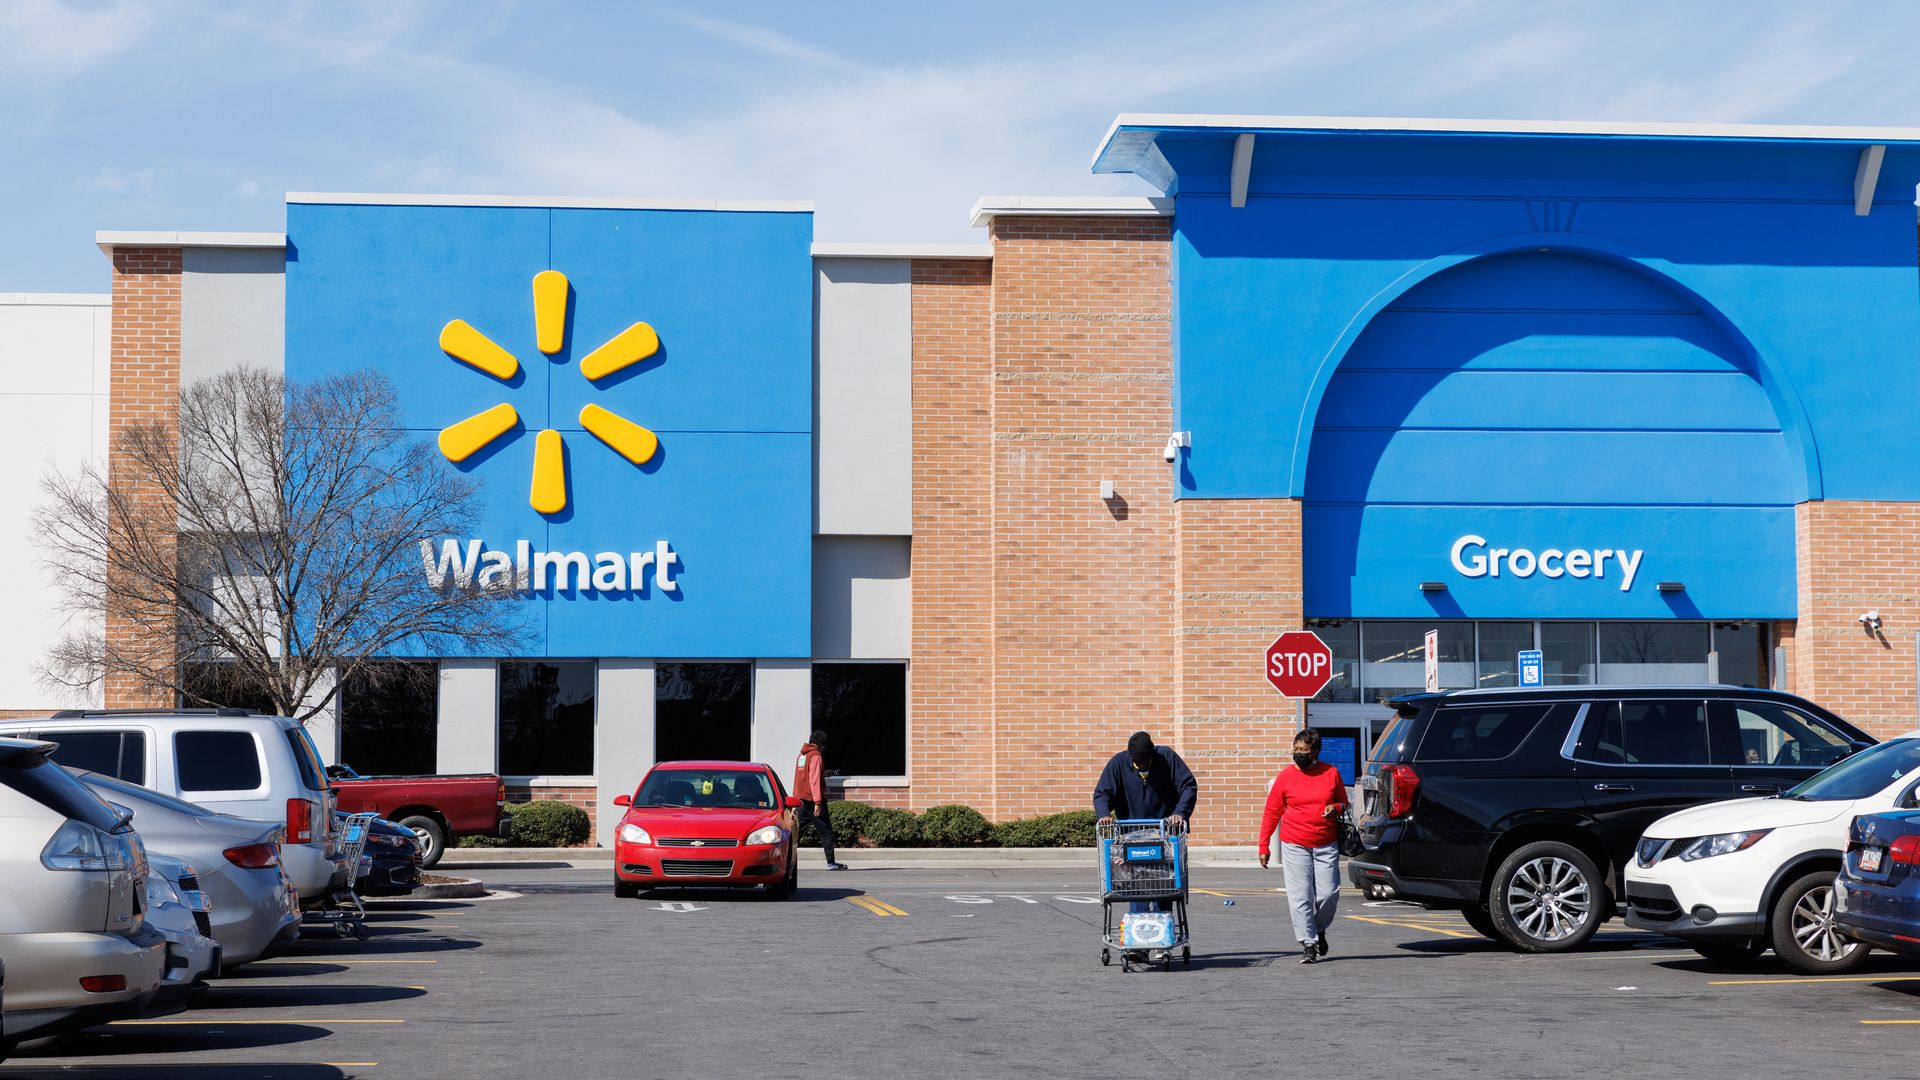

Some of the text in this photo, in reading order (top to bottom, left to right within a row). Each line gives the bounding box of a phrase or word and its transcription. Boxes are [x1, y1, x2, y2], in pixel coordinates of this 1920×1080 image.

[420, 539, 677, 592] Walmart
[1450, 534, 1643, 591] Grocery
[1270, 652, 1327, 677] STOP
[943, 894, 1101, 904] STO
